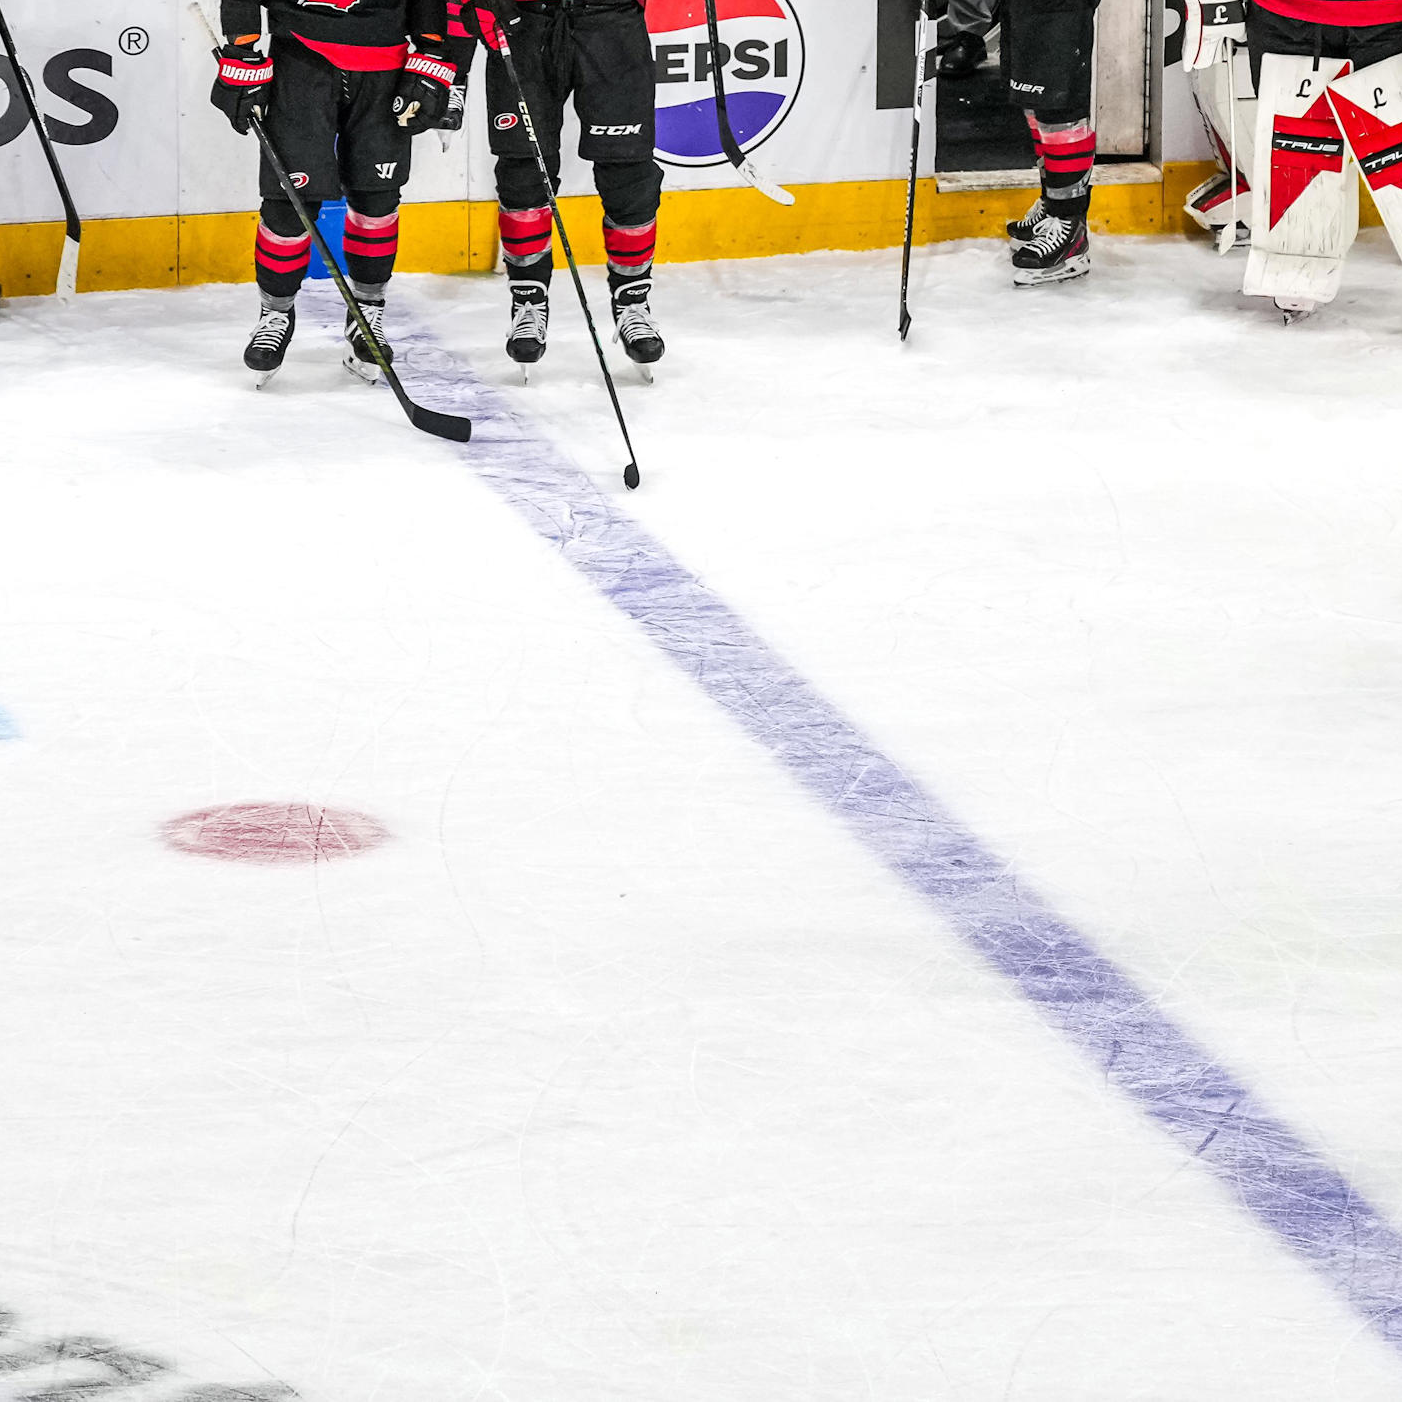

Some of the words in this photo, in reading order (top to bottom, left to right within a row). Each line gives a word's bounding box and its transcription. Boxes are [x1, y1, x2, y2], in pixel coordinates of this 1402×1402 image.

[656, 36, 788, 85] EPSI
[588, 123, 644, 136] CCM
[1274, 138, 1341, 154] TRUE
